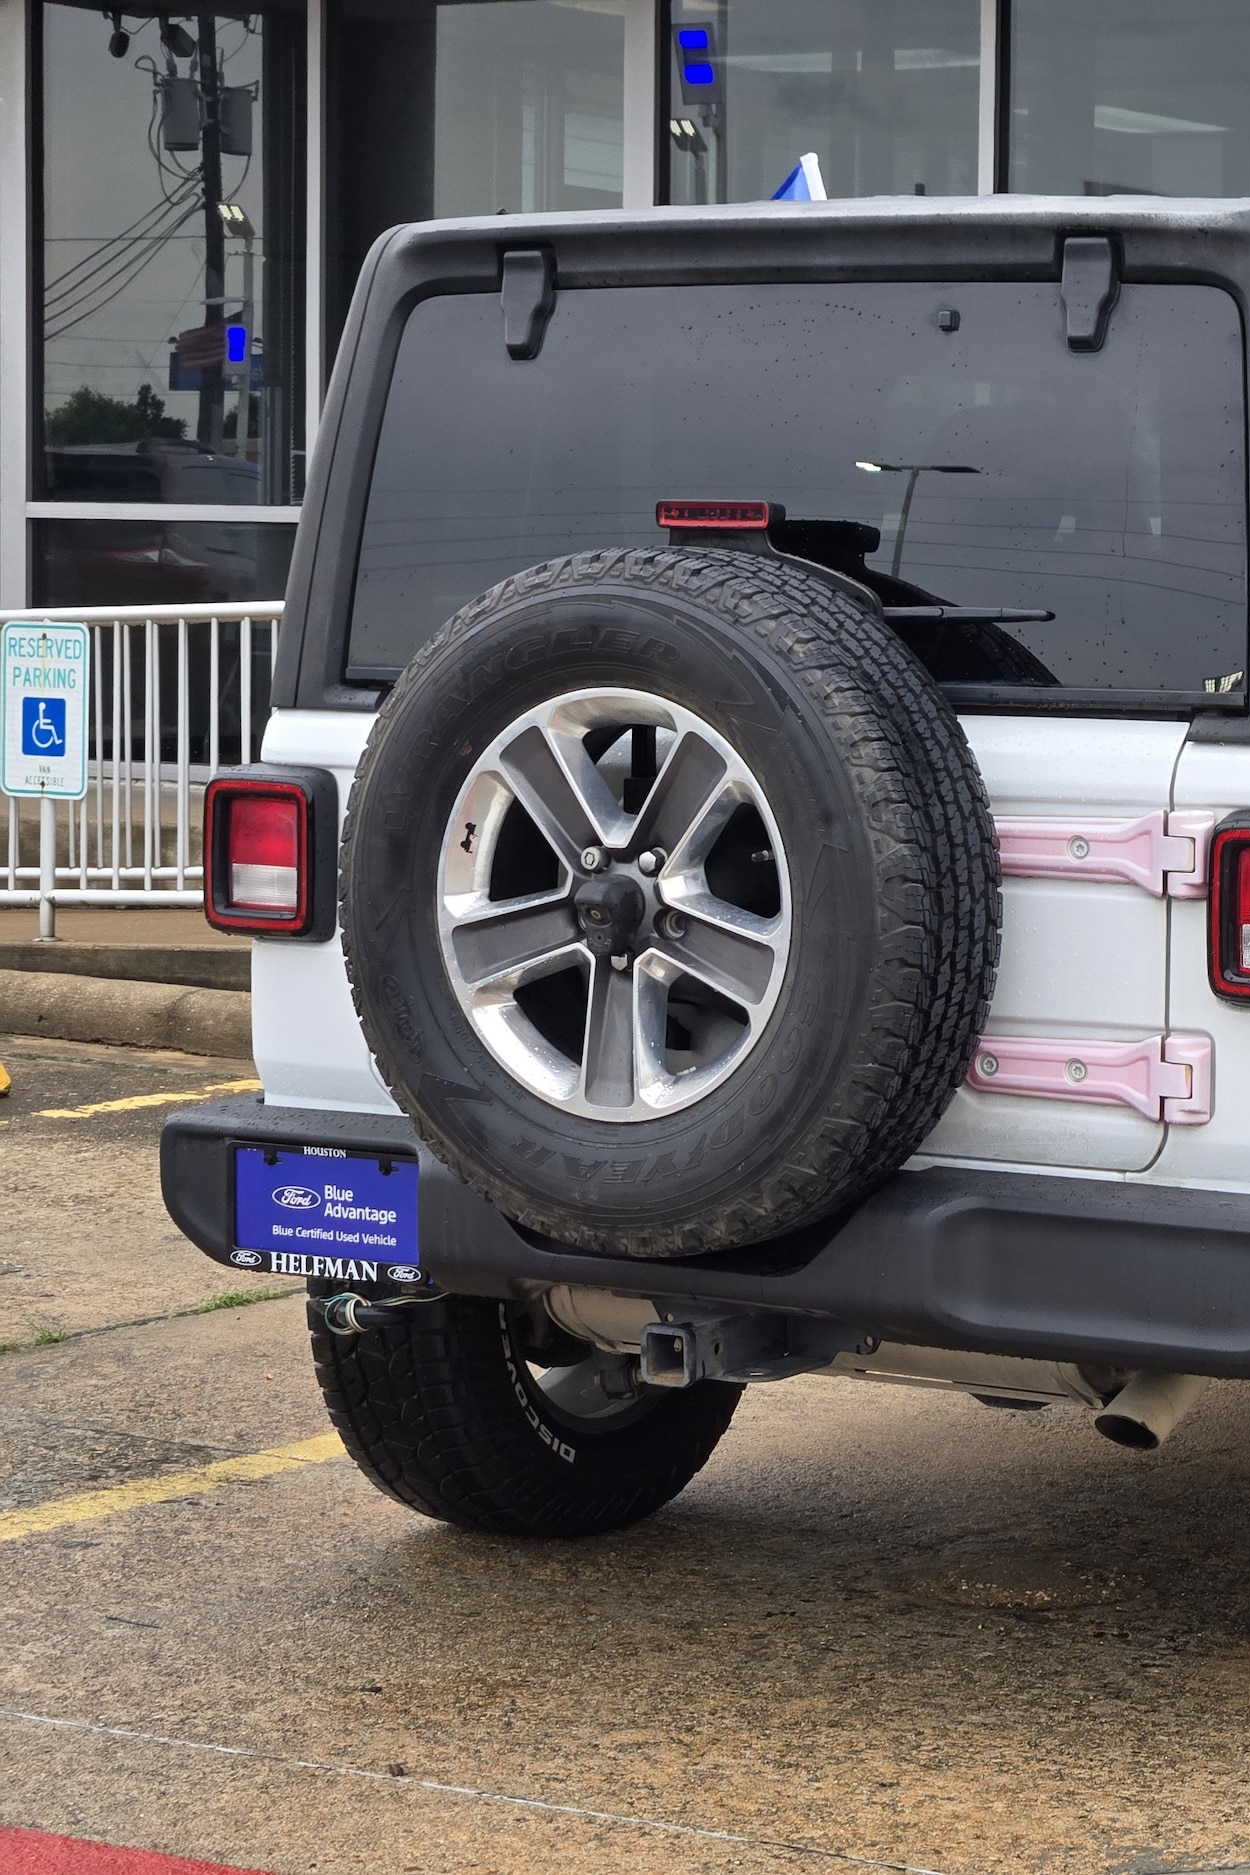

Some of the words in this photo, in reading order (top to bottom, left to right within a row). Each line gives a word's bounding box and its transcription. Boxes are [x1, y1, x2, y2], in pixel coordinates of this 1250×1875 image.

[8, 637, 82, 660] RESERVED
[12, 666, 76, 689] PARKING
[381, 627, 682, 831] WRANGLER
[38, 764, 51, 774] VAN
[508, 973, 820, 1186] GOODYEAR
[303, 1146, 347, 1158] HOUSTON
[280, 1188, 312, 1207] Ford
[324, 1185, 354, 1201] Blue
[324, 1202, 397, 1225] Advantage
[272, 1224, 294, 1237] Blue
[295, 1227, 334, 1241] Certified
[335, 1230, 360, 1244] Used
[362, 1233, 397, 1246] Vehicle
[269, 1251, 379, 1282] HELFMAN
